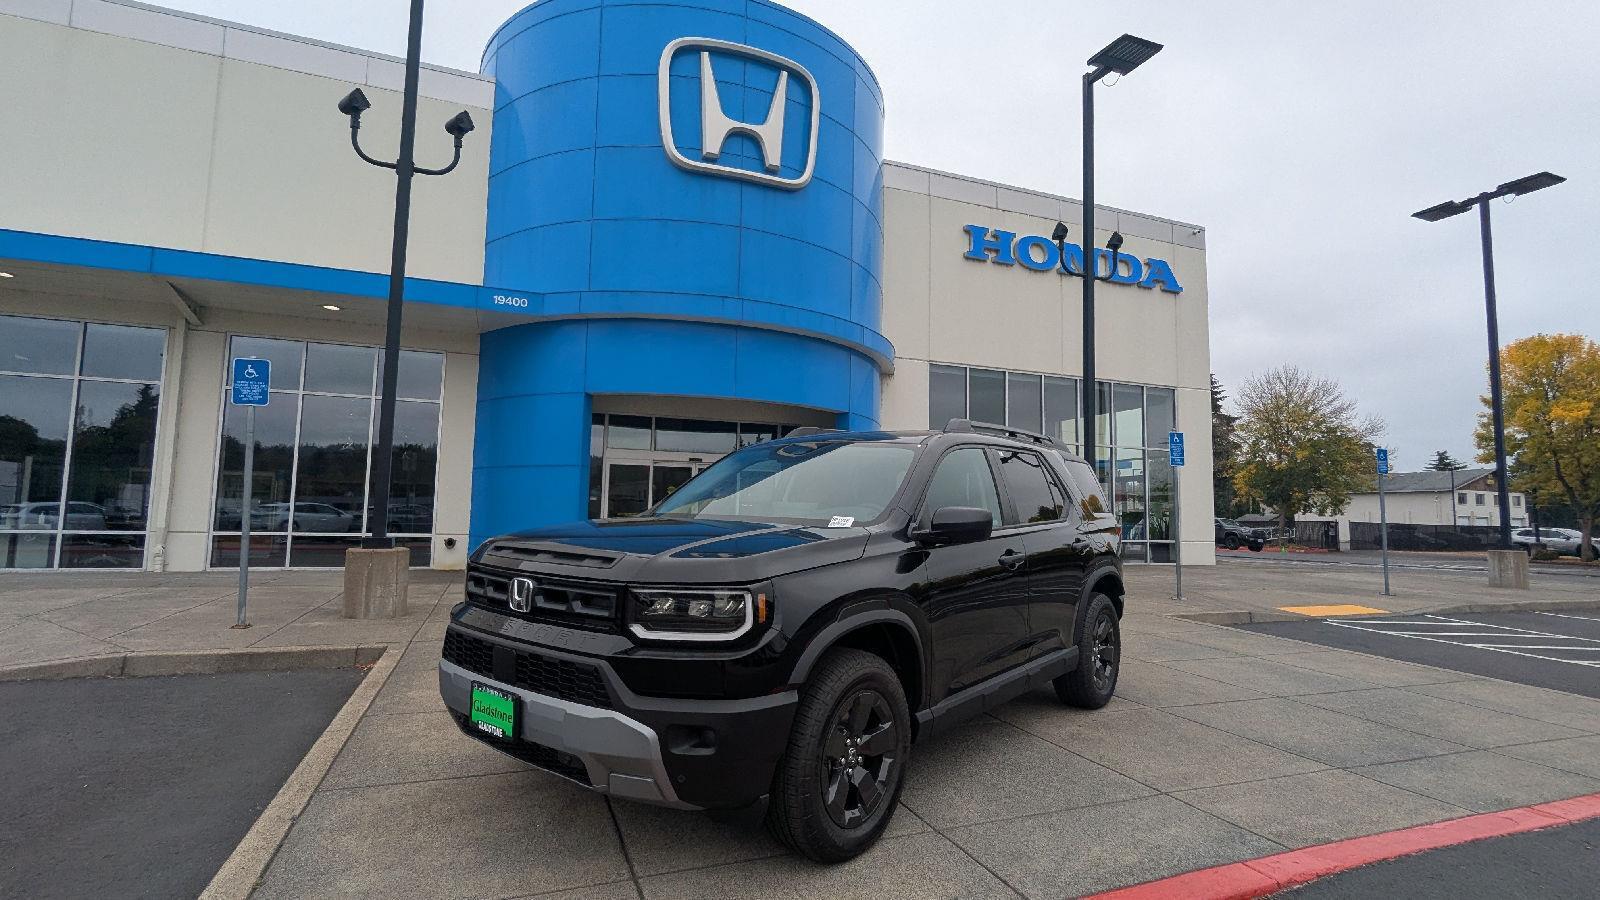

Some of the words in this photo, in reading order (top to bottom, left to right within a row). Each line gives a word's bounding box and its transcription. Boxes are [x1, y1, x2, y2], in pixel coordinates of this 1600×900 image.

[963, 224, 1184, 294] HONDA
[493, 295, 528, 308] 19400
[473, 699, 513, 724] Gladstone
